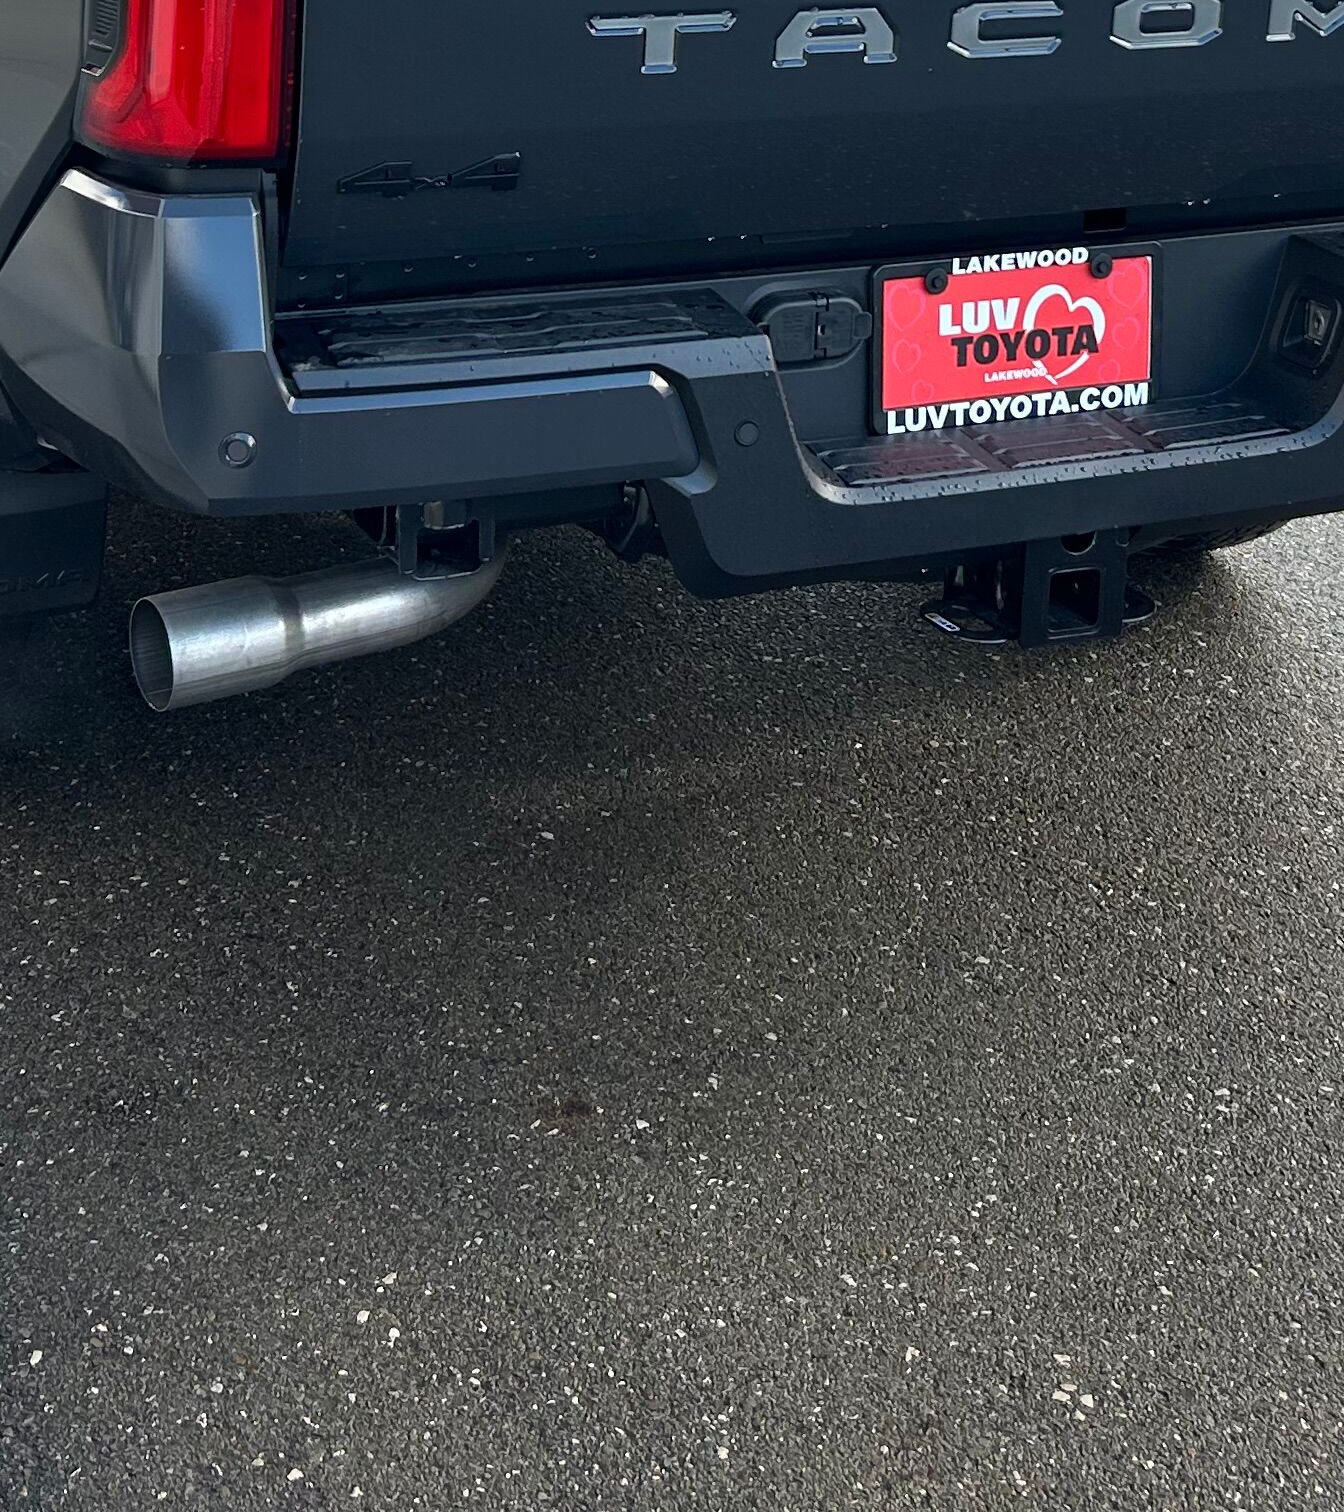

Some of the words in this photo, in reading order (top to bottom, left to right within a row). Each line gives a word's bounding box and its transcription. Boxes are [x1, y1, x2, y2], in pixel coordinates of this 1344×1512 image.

[952, 246, 1090, 276] LAKEWOOD
[938, 296, 1021, 337] LUV
[951, 324, 1099, 368] TOYOTA
[984, 366, 1047, 384] LAKEWOOD
[887, 382, 1149, 435] LUVTOYOTA.COM
